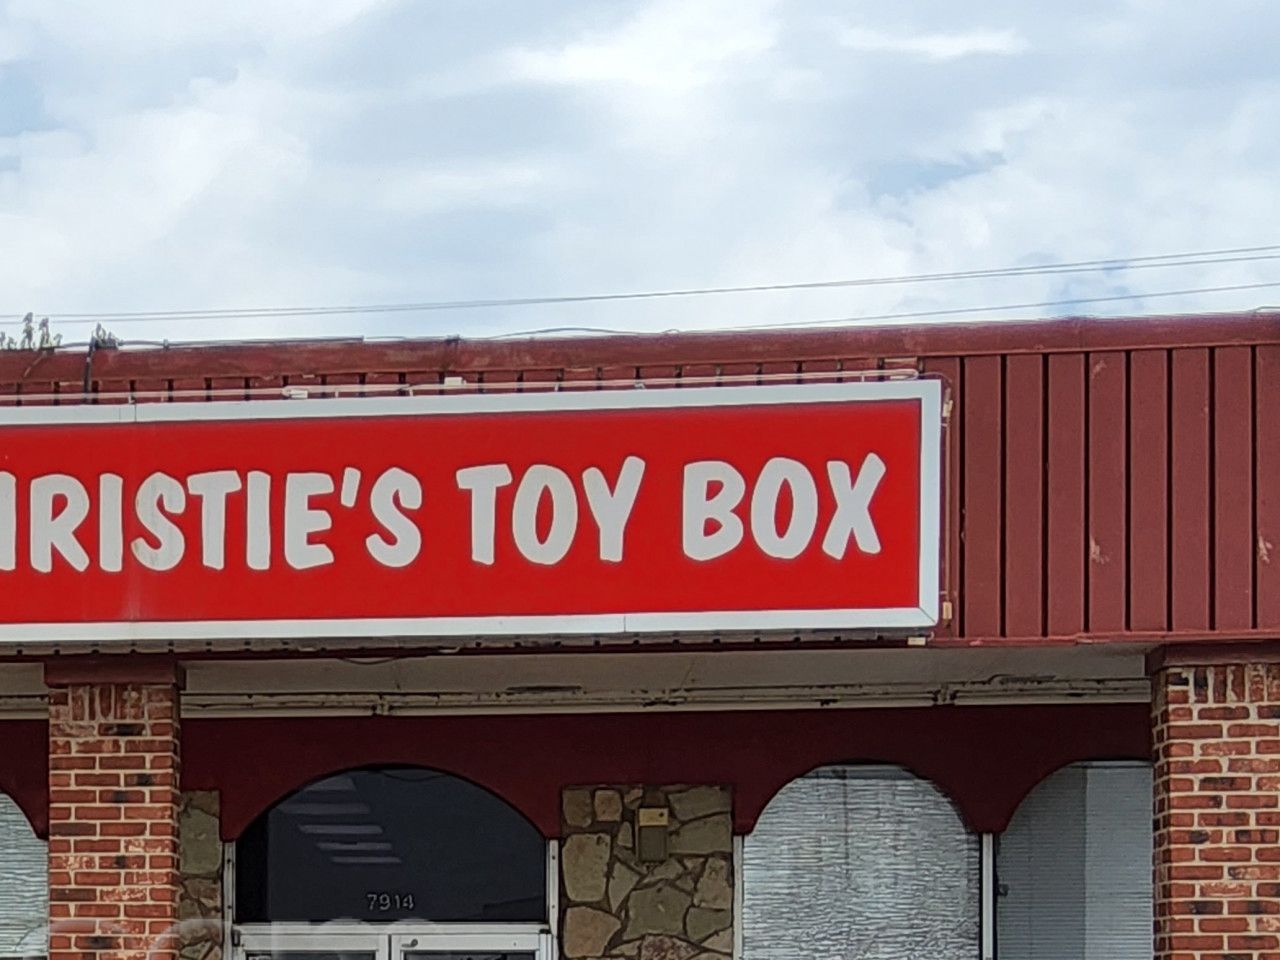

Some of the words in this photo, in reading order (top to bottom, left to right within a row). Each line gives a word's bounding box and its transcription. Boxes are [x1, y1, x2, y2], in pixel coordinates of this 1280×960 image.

[456, 456, 646, 566] TOY
[682, 452, 887, 561] BOX
[367, 893, 414, 911] 7914
